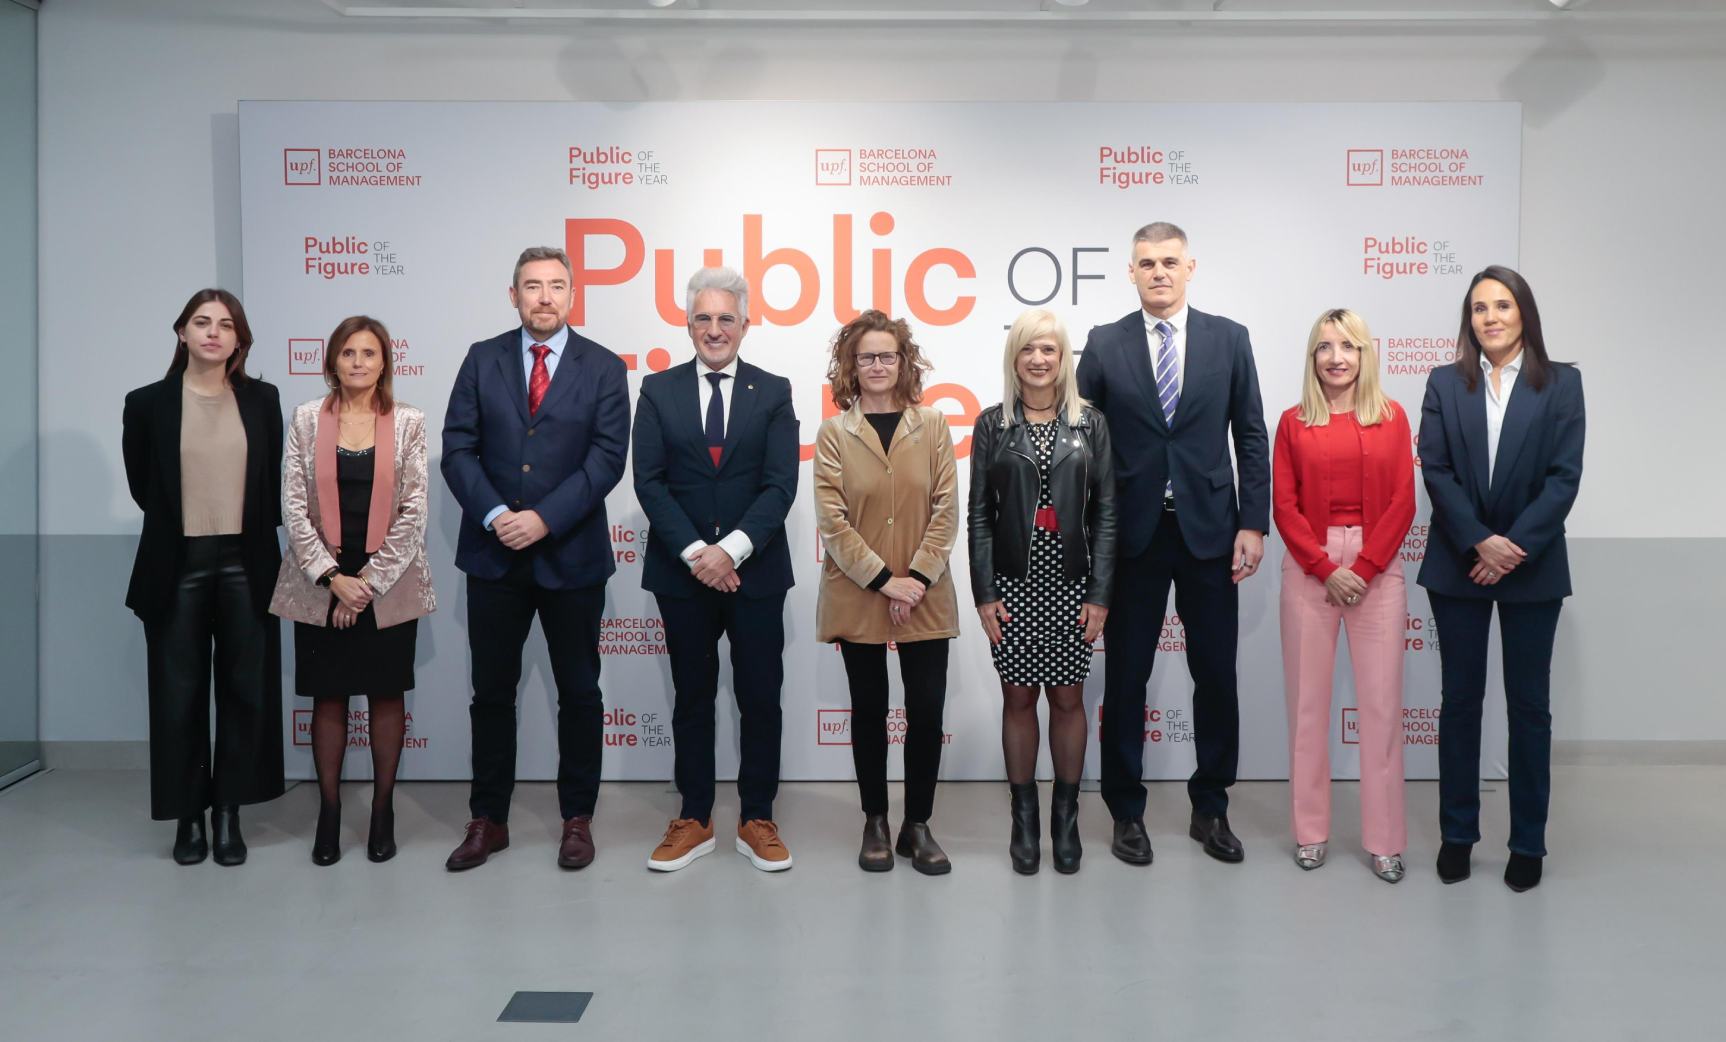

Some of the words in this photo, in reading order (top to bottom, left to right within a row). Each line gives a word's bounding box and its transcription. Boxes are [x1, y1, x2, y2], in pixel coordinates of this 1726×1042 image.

[328, 148, 405, 159] BARCELONA
[568, 146, 632, 164] Public
[638, 151, 655, 161] OF
[859, 149, 937, 159] BARCELONA
[1100, 146, 1163, 164] Public
[1168, 151, 1185, 161] OF
[1391, 149, 1469, 160] BARCELONA
[328, 162, 382, 172] SCHOOL
[386, 162, 403, 172] OF
[638, 163, 660, 173] THE
[859, 162, 914, 173] SCHOOL
[917, 162, 934, 172] OF
[1168, 163, 1191, 173] THE
[1391, 162, 1445, 173] SCHOOL
[1449, 162, 1466, 173] OF
[328, 175, 421, 185] MANAGEMENT
[568, 167, 634, 189] Figure
[638, 175, 668, 185] YEAR
[859, 175, 952, 186] MANAGEMENT
[1099, 167, 1164, 189] Figure
[1168, 175, 1199, 185] YEAR
[1391, 175, 1484, 186] MANAGEMENT
[304, 236, 368, 254] Public
[373, 241, 391, 251] OF
[1364, 236, 1427, 254] Public
[1433, 241, 1450, 251] OF
[373, 253, 397, 263] THE
[1433, 253, 1456, 263] THE
[305, 257, 369, 279] Figure
[373, 265, 404, 275] YEAR
[565, 211, 976, 327] Public
[1364, 257, 1428, 279] Figure
[1433, 264, 1463, 274] YEAR
[1007, 247, 1109, 306] OF
[1388, 338, 1458, 349] BARCELON
[1388, 352, 1440, 361] SCHOOL
[600, 618, 664, 629] BARCELON
[600, 631, 650, 642] SCHOOL
[654, 631, 665, 642] O
[599, 644, 668, 655] MANAGEM
[603, 708, 636, 726] blic
[641, 713, 657, 724] OF
[1166, 709, 1182, 720] OF
[641, 725, 664, 735] THE
[1166, 721, 1188, 731] THE
[1402, 721, 1437, 732] HOOL
[641, 736, 671, 747] YEAR
